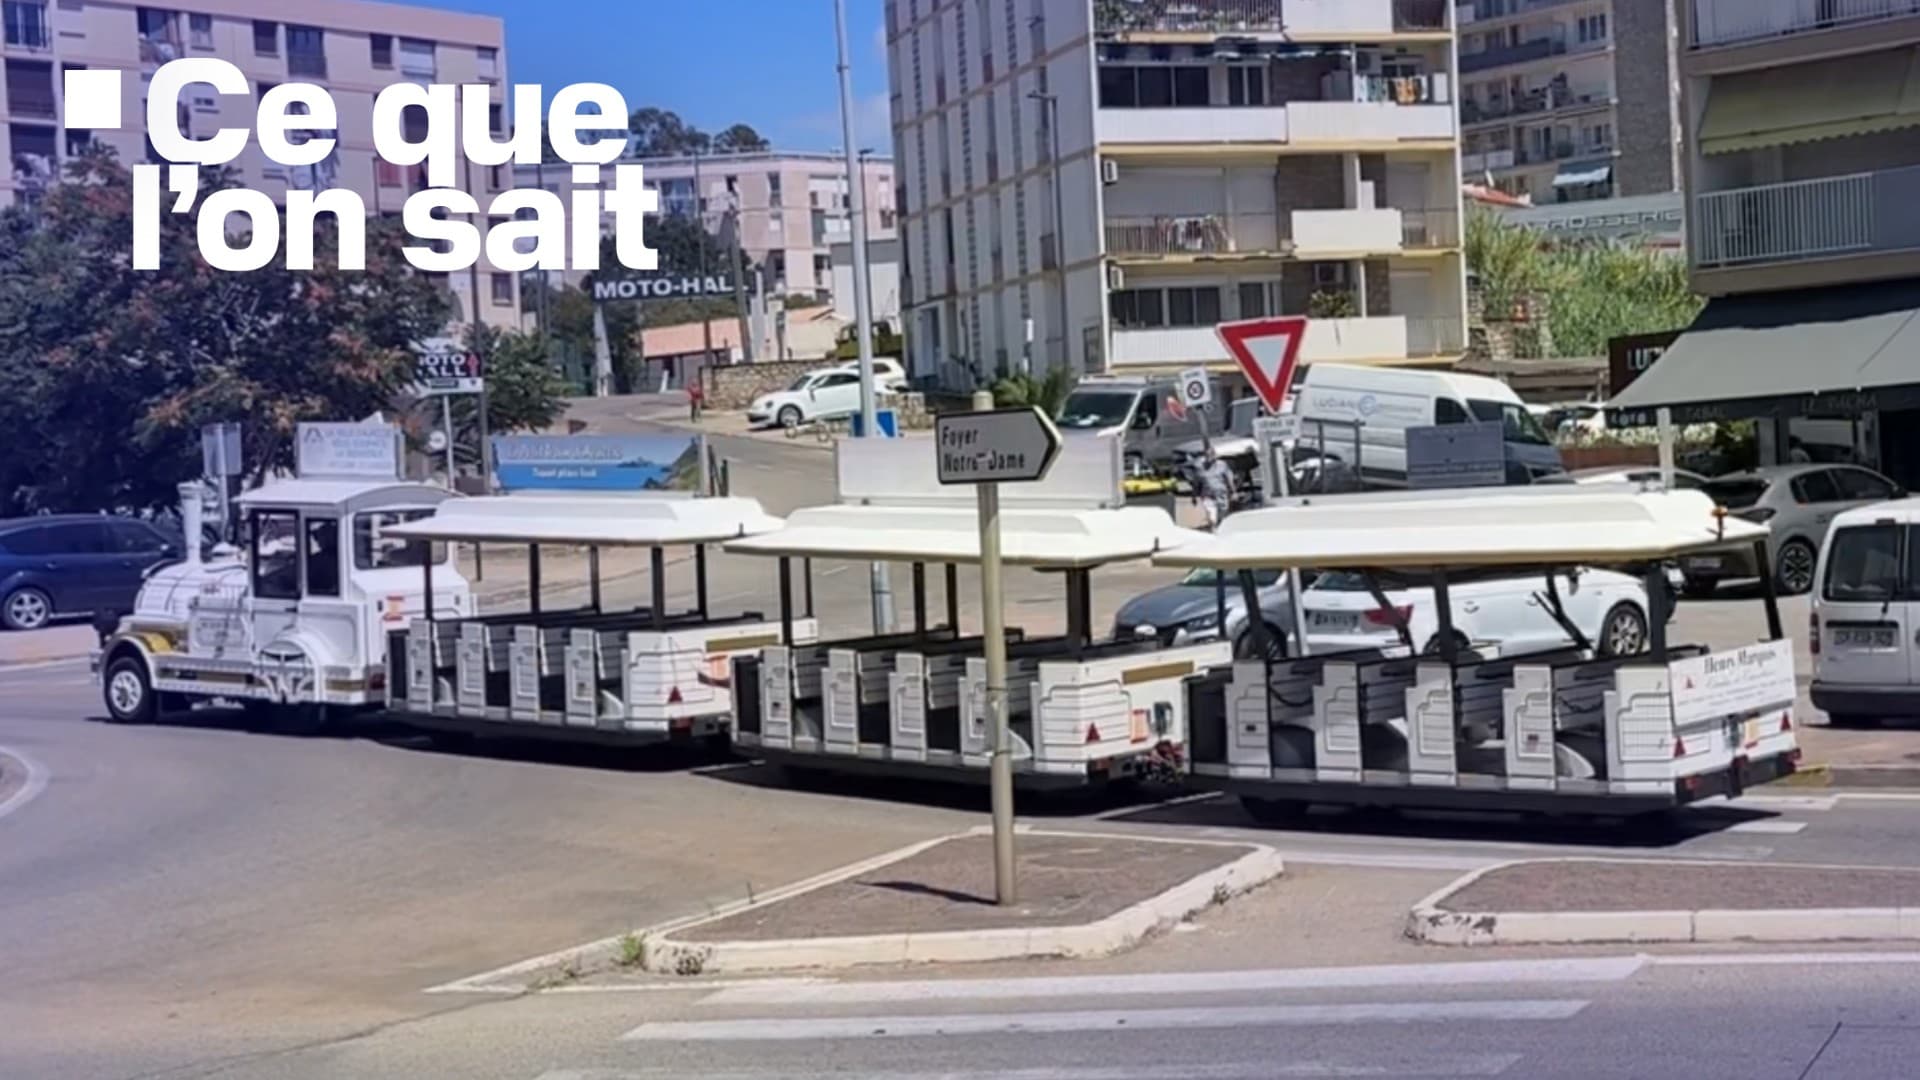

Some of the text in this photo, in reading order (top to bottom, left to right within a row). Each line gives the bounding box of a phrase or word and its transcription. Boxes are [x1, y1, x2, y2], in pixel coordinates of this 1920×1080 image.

[594, 276, 749, 300] MOTO-HAL
[418, 352, 467, 367] OTO
[942, 426, 978, 450] Foyer
